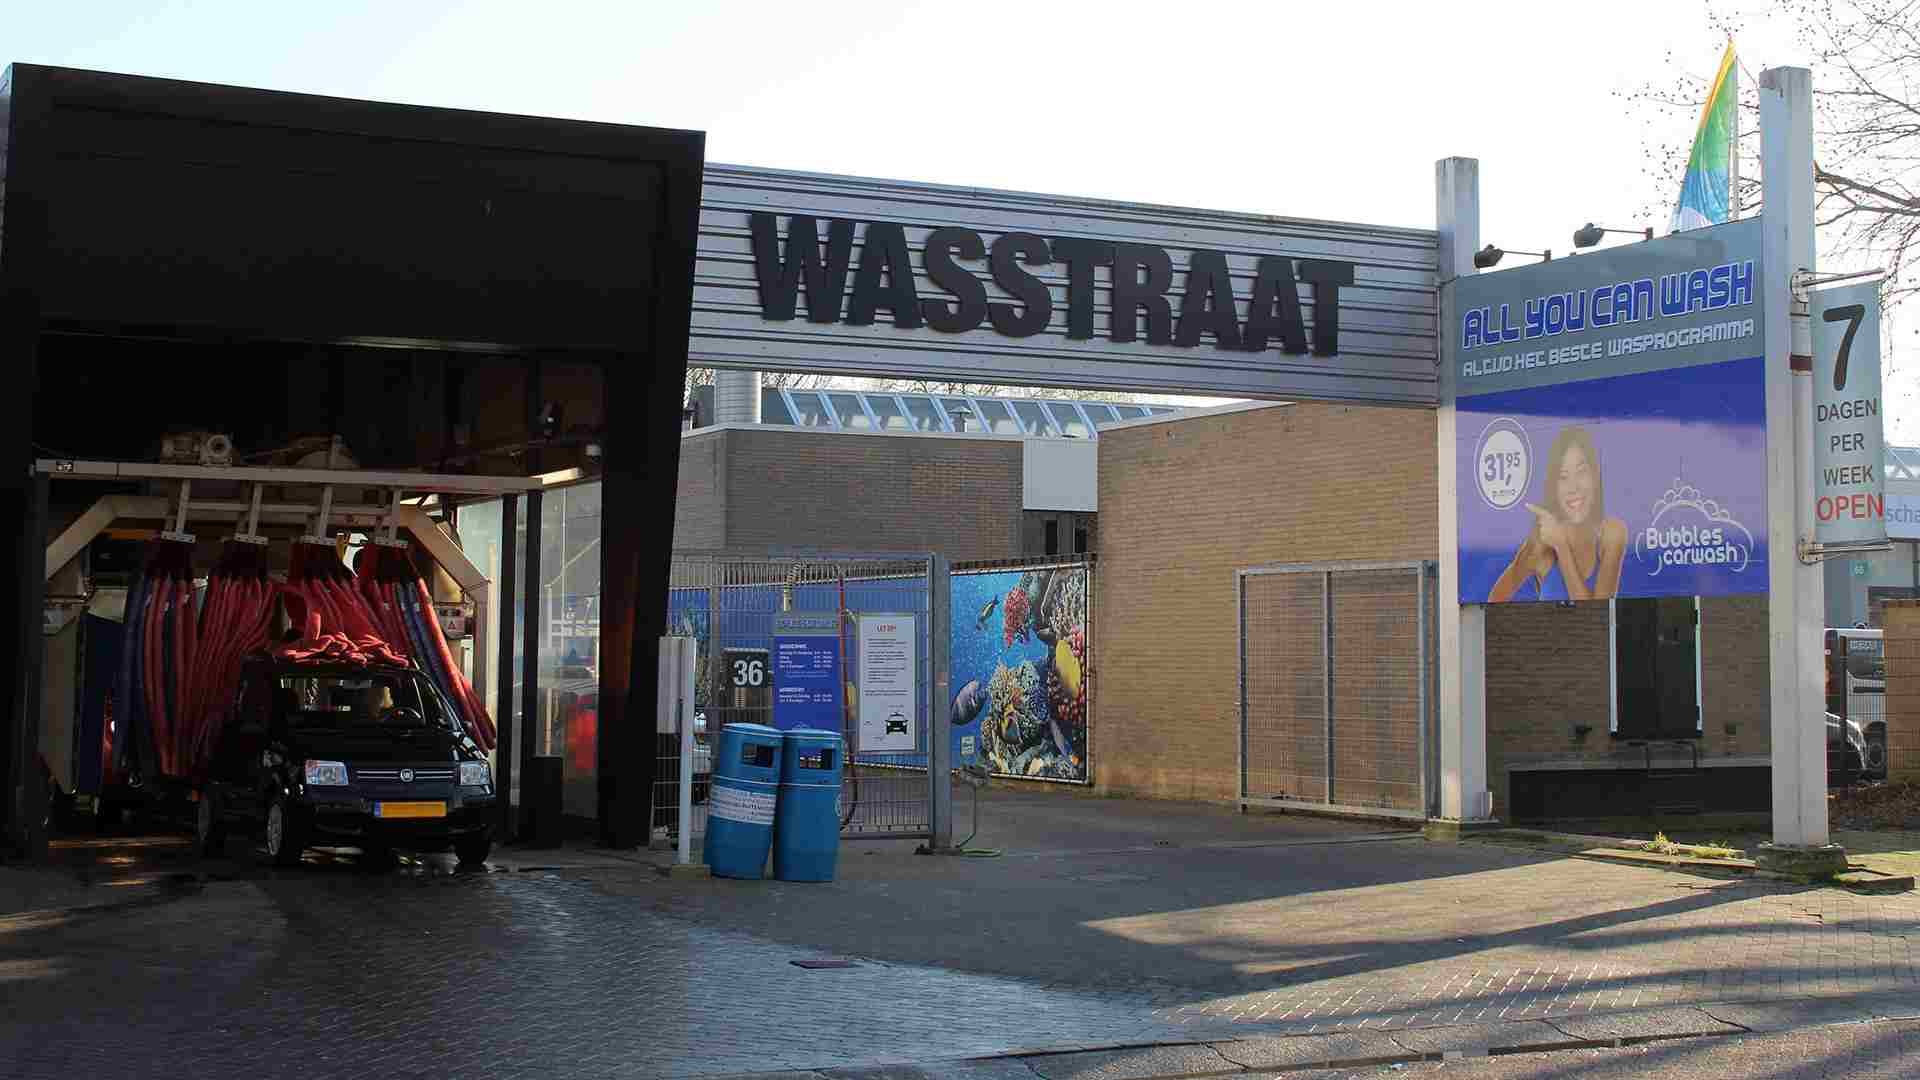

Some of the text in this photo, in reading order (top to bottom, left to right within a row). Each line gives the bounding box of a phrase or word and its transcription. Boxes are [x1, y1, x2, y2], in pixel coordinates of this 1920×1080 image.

[748, 211, 1355, 357] WASSTRAAT
[1463, 260, 1754, 350] ALL YOU CAN WASH
[1606, 318, 1755, 356] WASPROGRAMMA
[1822, 303, 1865, 391] 7
[1816, 397, 1878, 423] DAGEN
[1830, 432, 1865, 453] PER
[1823, 464, 1875, 487] WEEK
[1815, 493, 1884, 522] OPEN
[1646, 525, 1723, 552] Bubbles
[1662, 542, 1739, 567] carwash
[733, 659, 764, 687] 36
